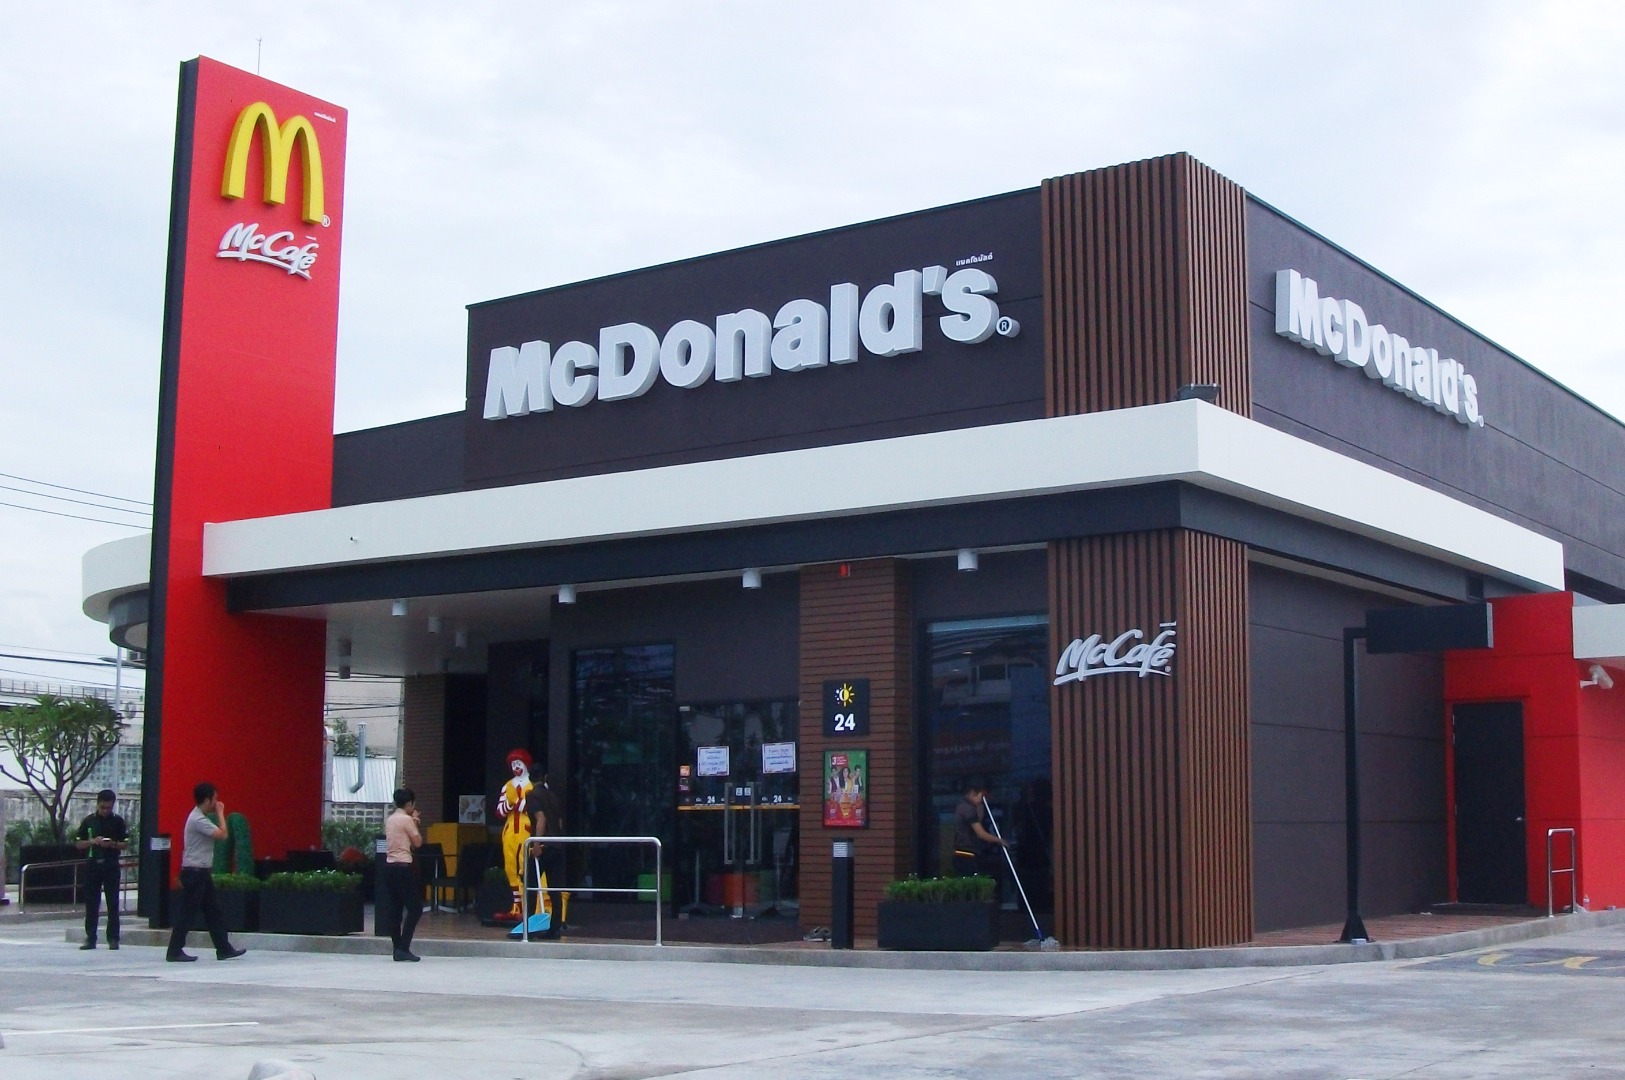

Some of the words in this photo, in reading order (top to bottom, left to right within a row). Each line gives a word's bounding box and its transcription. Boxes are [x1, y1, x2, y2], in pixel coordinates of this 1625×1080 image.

[483, 264, 1000, 421] McDonald's
[1275, 268, 1479, 430] McDonald's
[834, 713, 856, 731] 24
[707, 795, 716, 804] 24
[773, 794, 782, 803] 24
